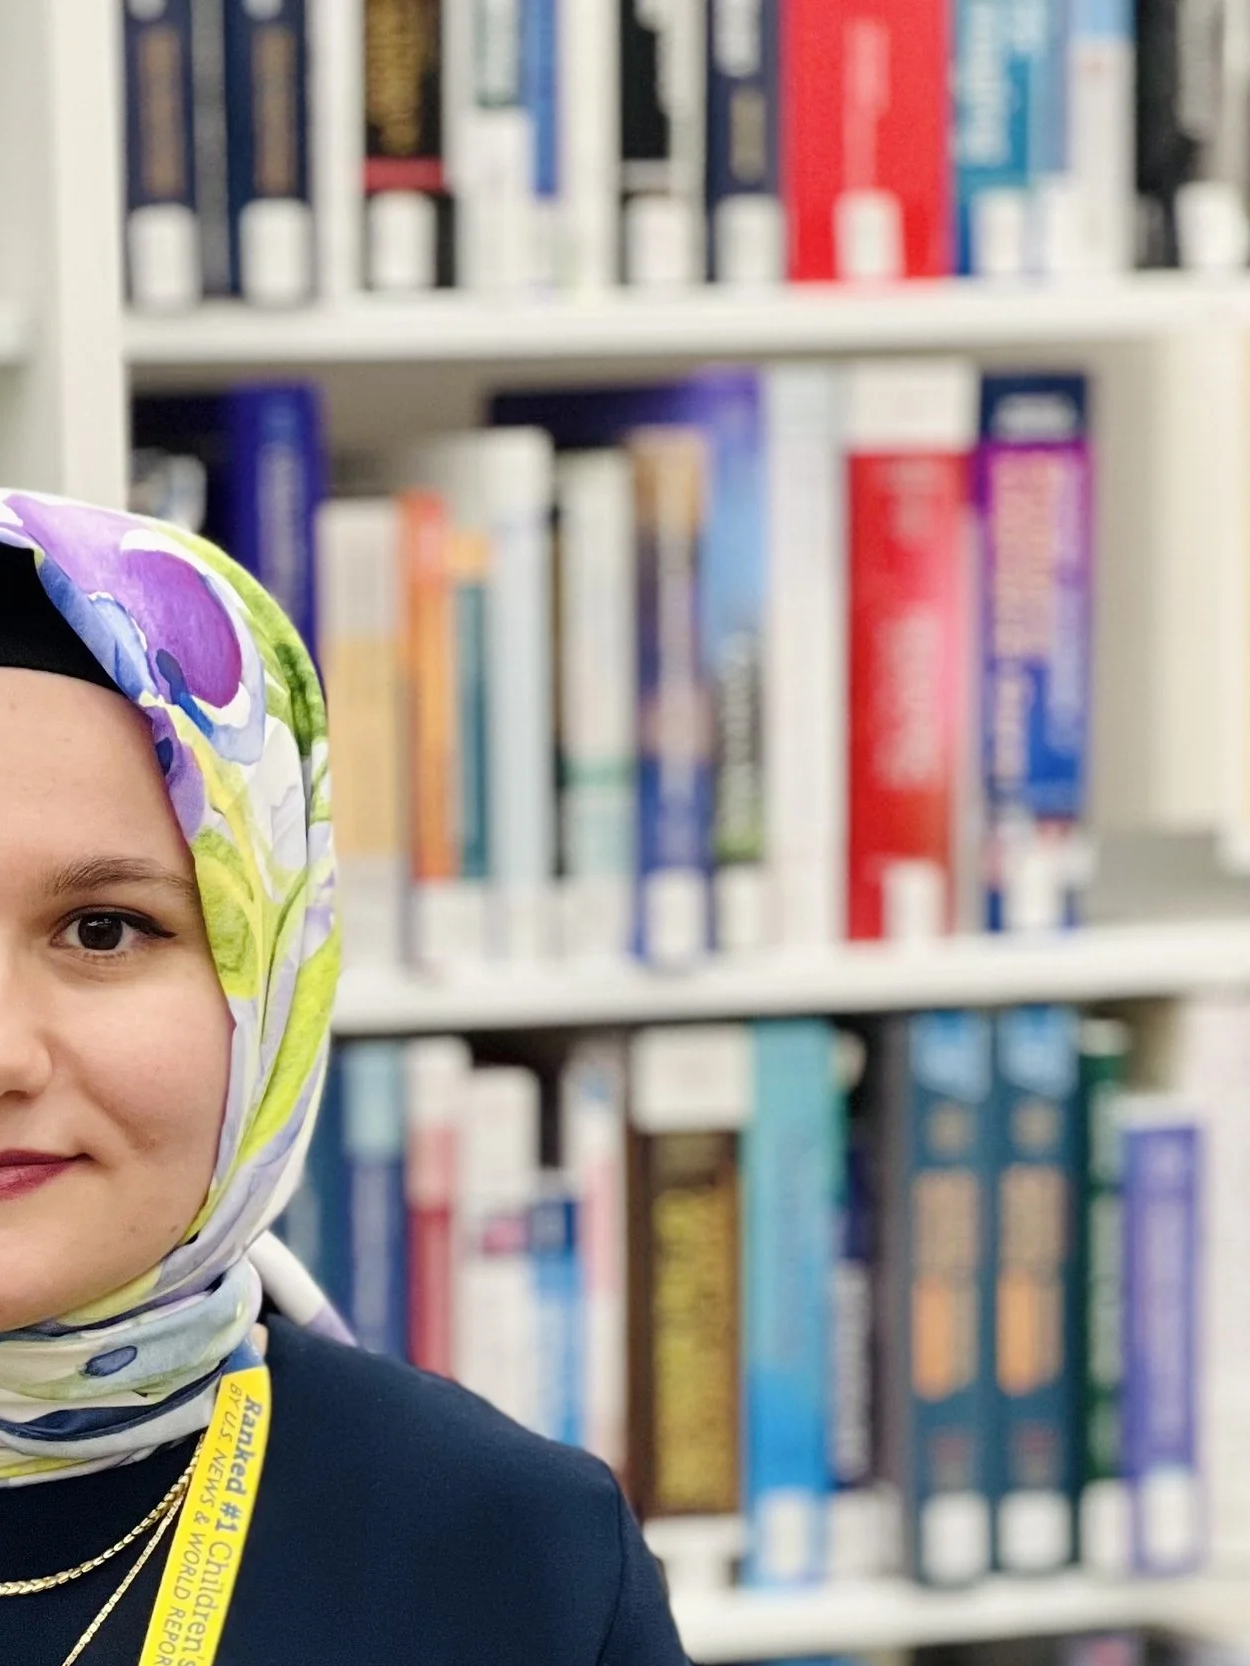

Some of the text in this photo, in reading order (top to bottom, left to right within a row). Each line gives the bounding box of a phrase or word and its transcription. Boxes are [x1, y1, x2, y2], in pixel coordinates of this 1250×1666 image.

[228, 1382, 243, 1410] BY
[218, 1410, 237, 1443] U.S.
[225, 1393, 263, 1496] Ranked
[200, 1447, 228, 1508] NEWS
[193, 1510, 210, 1525] &
[215, 1501, 242, 1533] #1
[173, 1532, 206, 1600] WORLD
